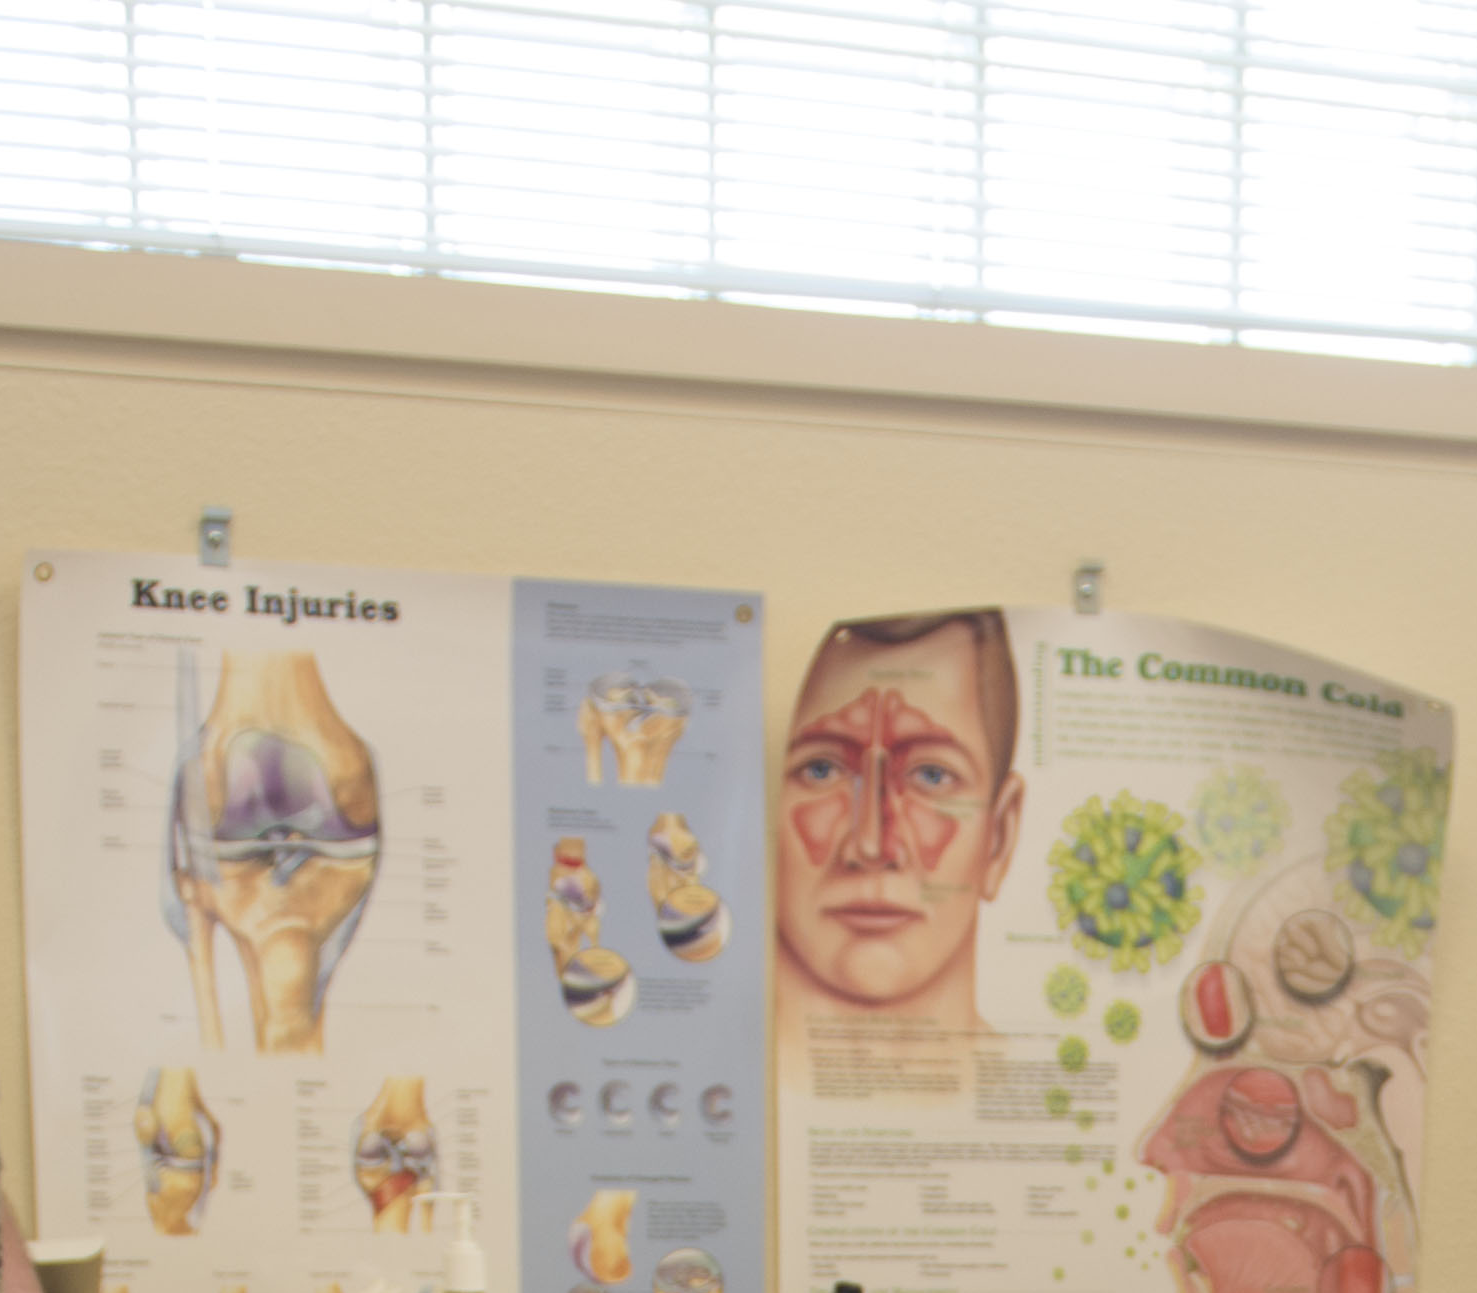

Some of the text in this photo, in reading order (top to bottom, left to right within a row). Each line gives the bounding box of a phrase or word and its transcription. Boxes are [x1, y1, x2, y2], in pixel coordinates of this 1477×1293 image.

[129, 577, 401, 624] Knee Injuries
[1057, 646, 1407, 719] The Common Cold
